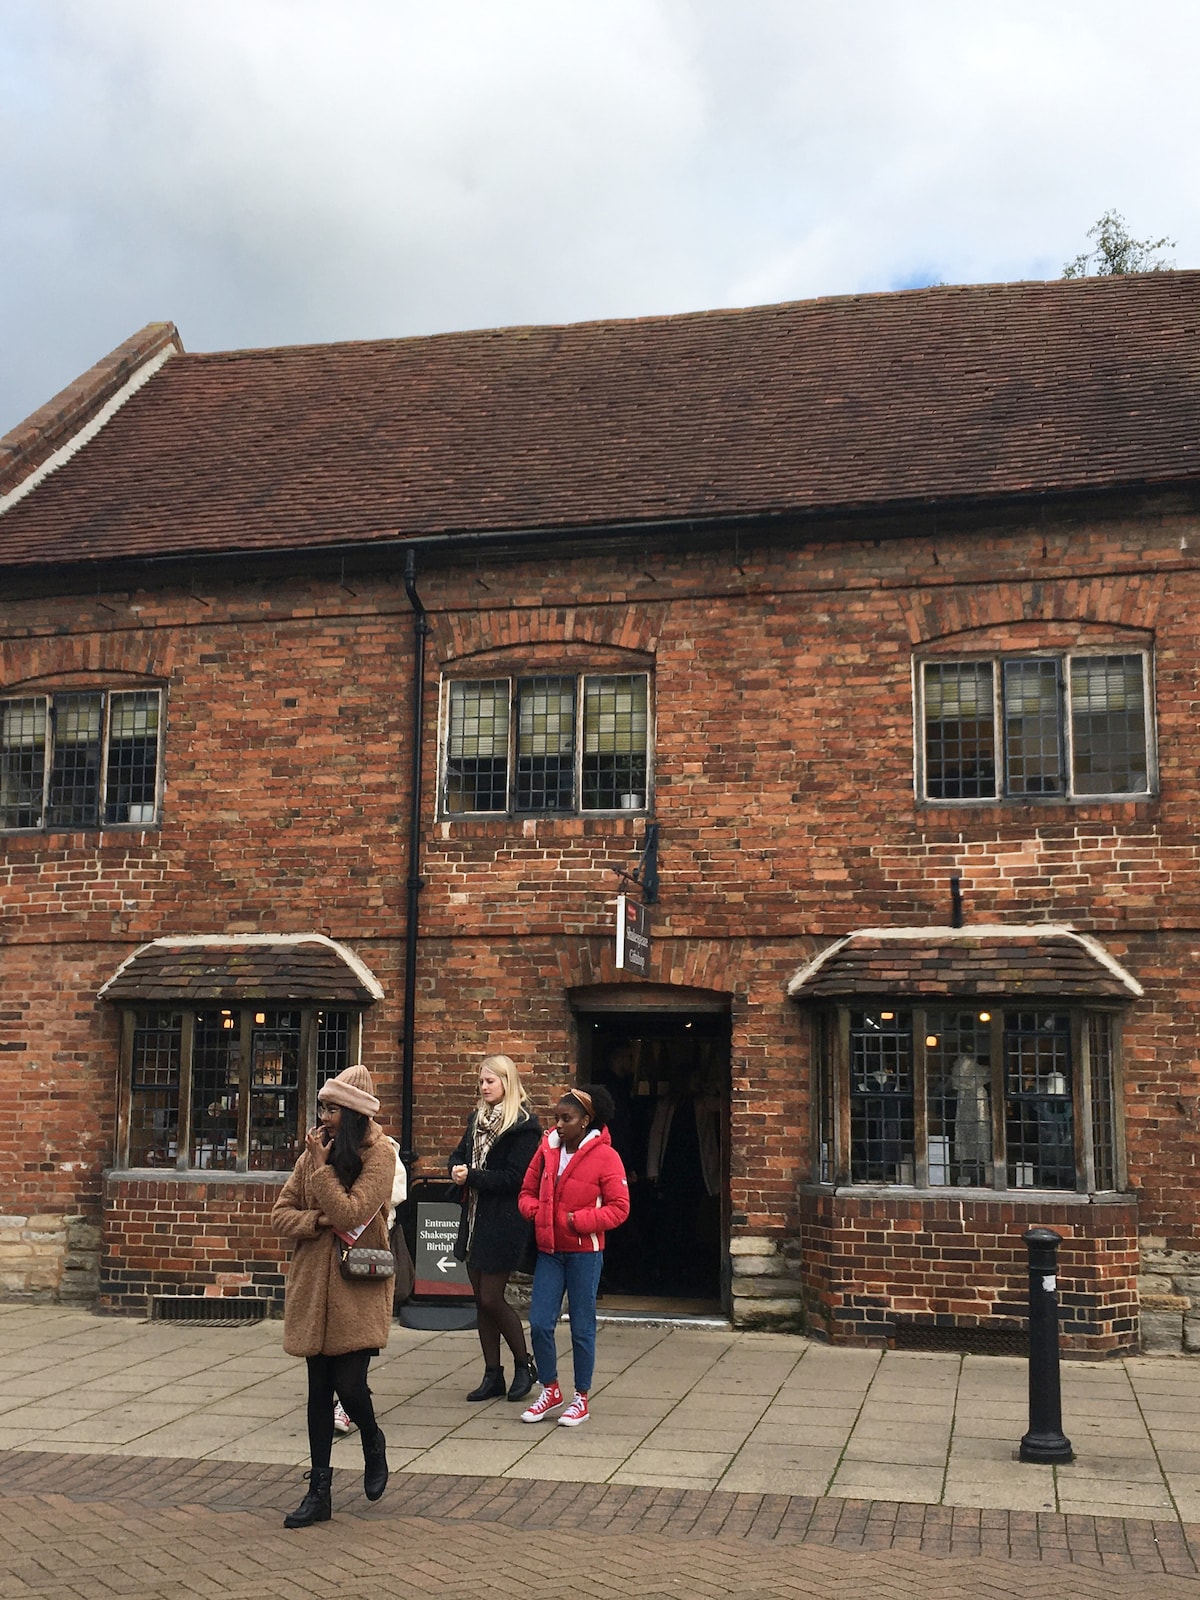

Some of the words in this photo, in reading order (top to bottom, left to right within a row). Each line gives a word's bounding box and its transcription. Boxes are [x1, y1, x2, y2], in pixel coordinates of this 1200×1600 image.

[425, 1219, 460, 1228] Entrance
[420, 1230, 459, 1241] Shakespe
[426, 1242, 454, 1253] Birthpl
